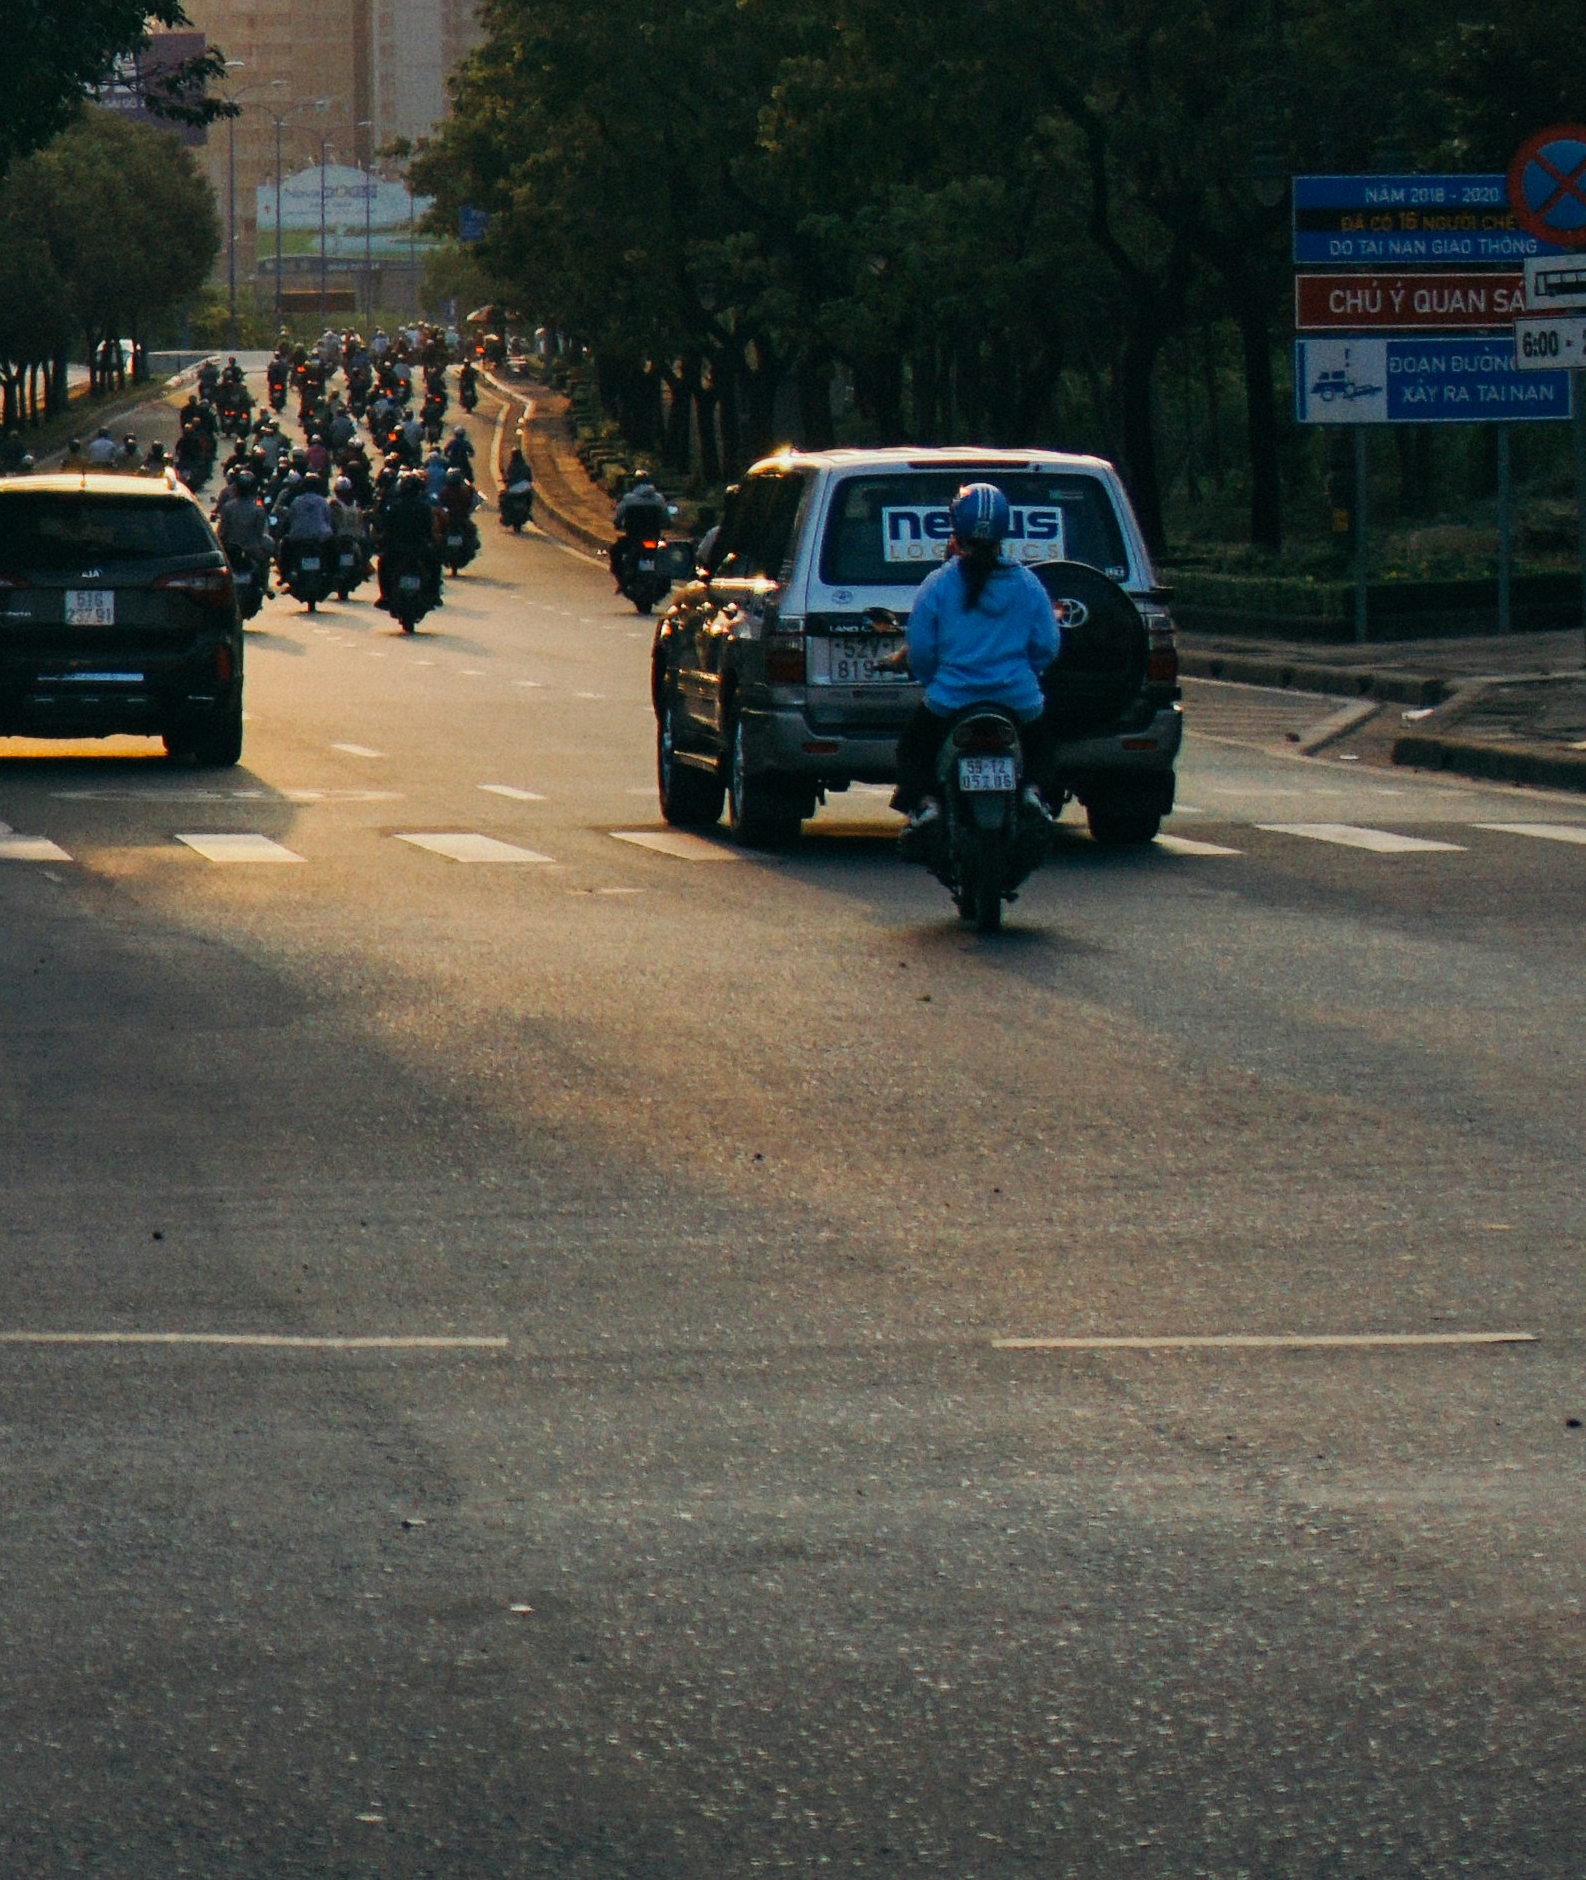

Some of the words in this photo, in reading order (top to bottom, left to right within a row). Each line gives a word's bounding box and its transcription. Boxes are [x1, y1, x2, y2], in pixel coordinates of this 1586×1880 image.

[1329, 240, 1353, 255] DO
[1431, 239, 1471, 254] GIAO
[1413, 288, 1486, 314] QUAN
[1493, 280, 1525, 313] SÁ
[1523, 329, 1559, 358] 6:00
[1451, 347, 1516, 372] ĐƯỜN
[1444, 385, 1470, 402] RA
[890, 544, 1059, 560] LOGICS
